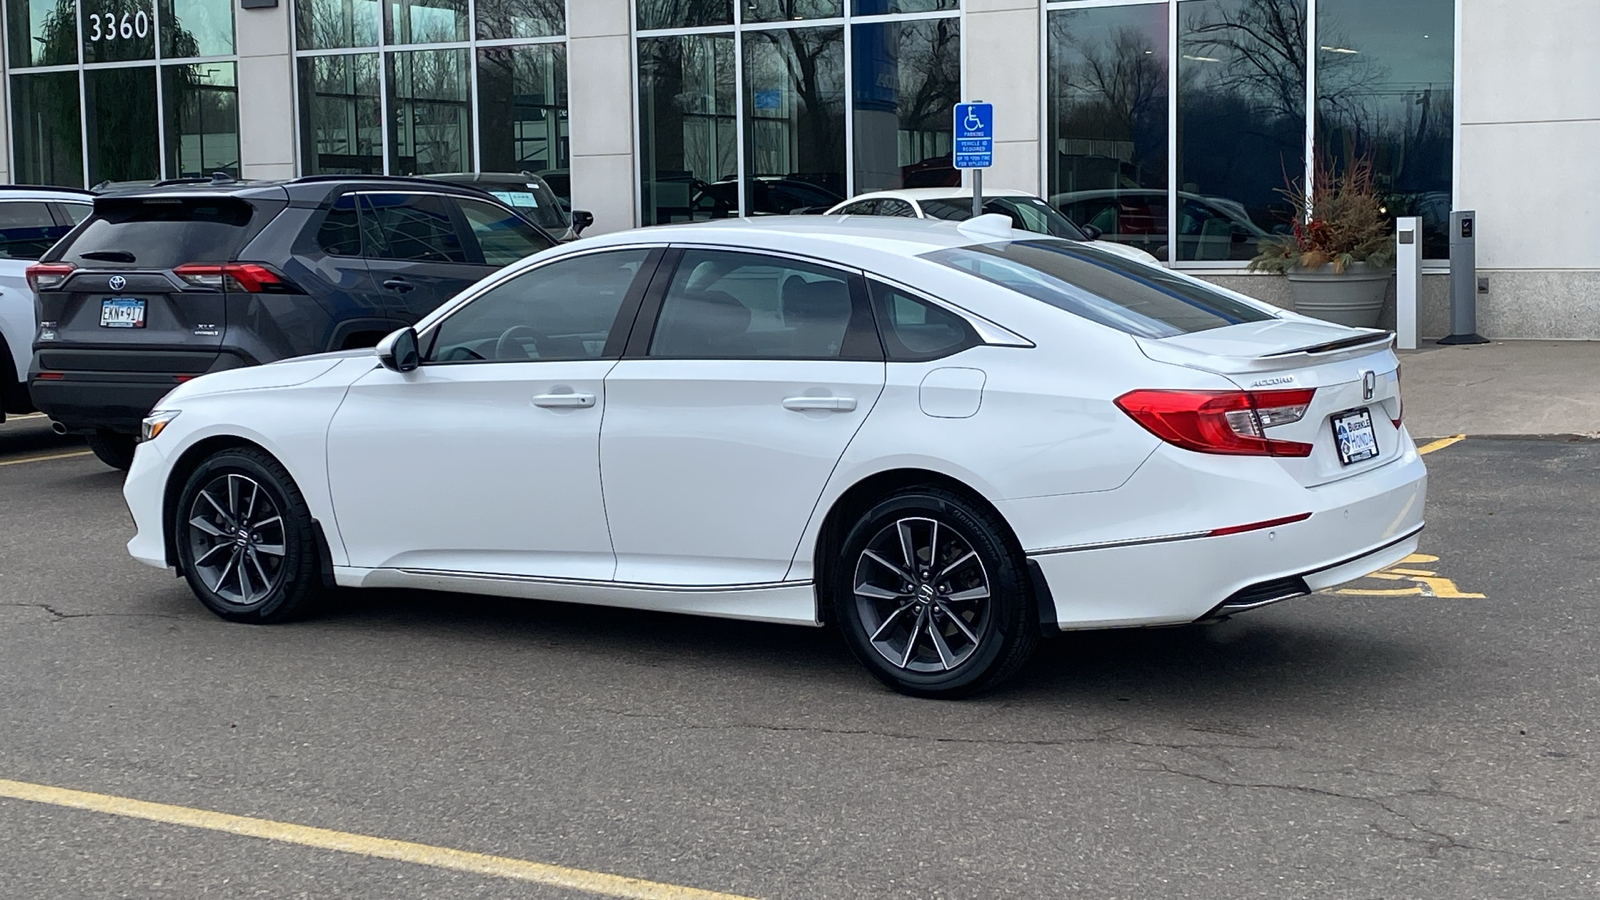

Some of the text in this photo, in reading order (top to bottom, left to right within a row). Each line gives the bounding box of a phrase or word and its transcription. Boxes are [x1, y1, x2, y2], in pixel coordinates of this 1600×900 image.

[89, 10, 149, 42] 3360
[1250, 375, 1295, 388] ACCORD
[1350, 431, 1374, 450] HONDA
